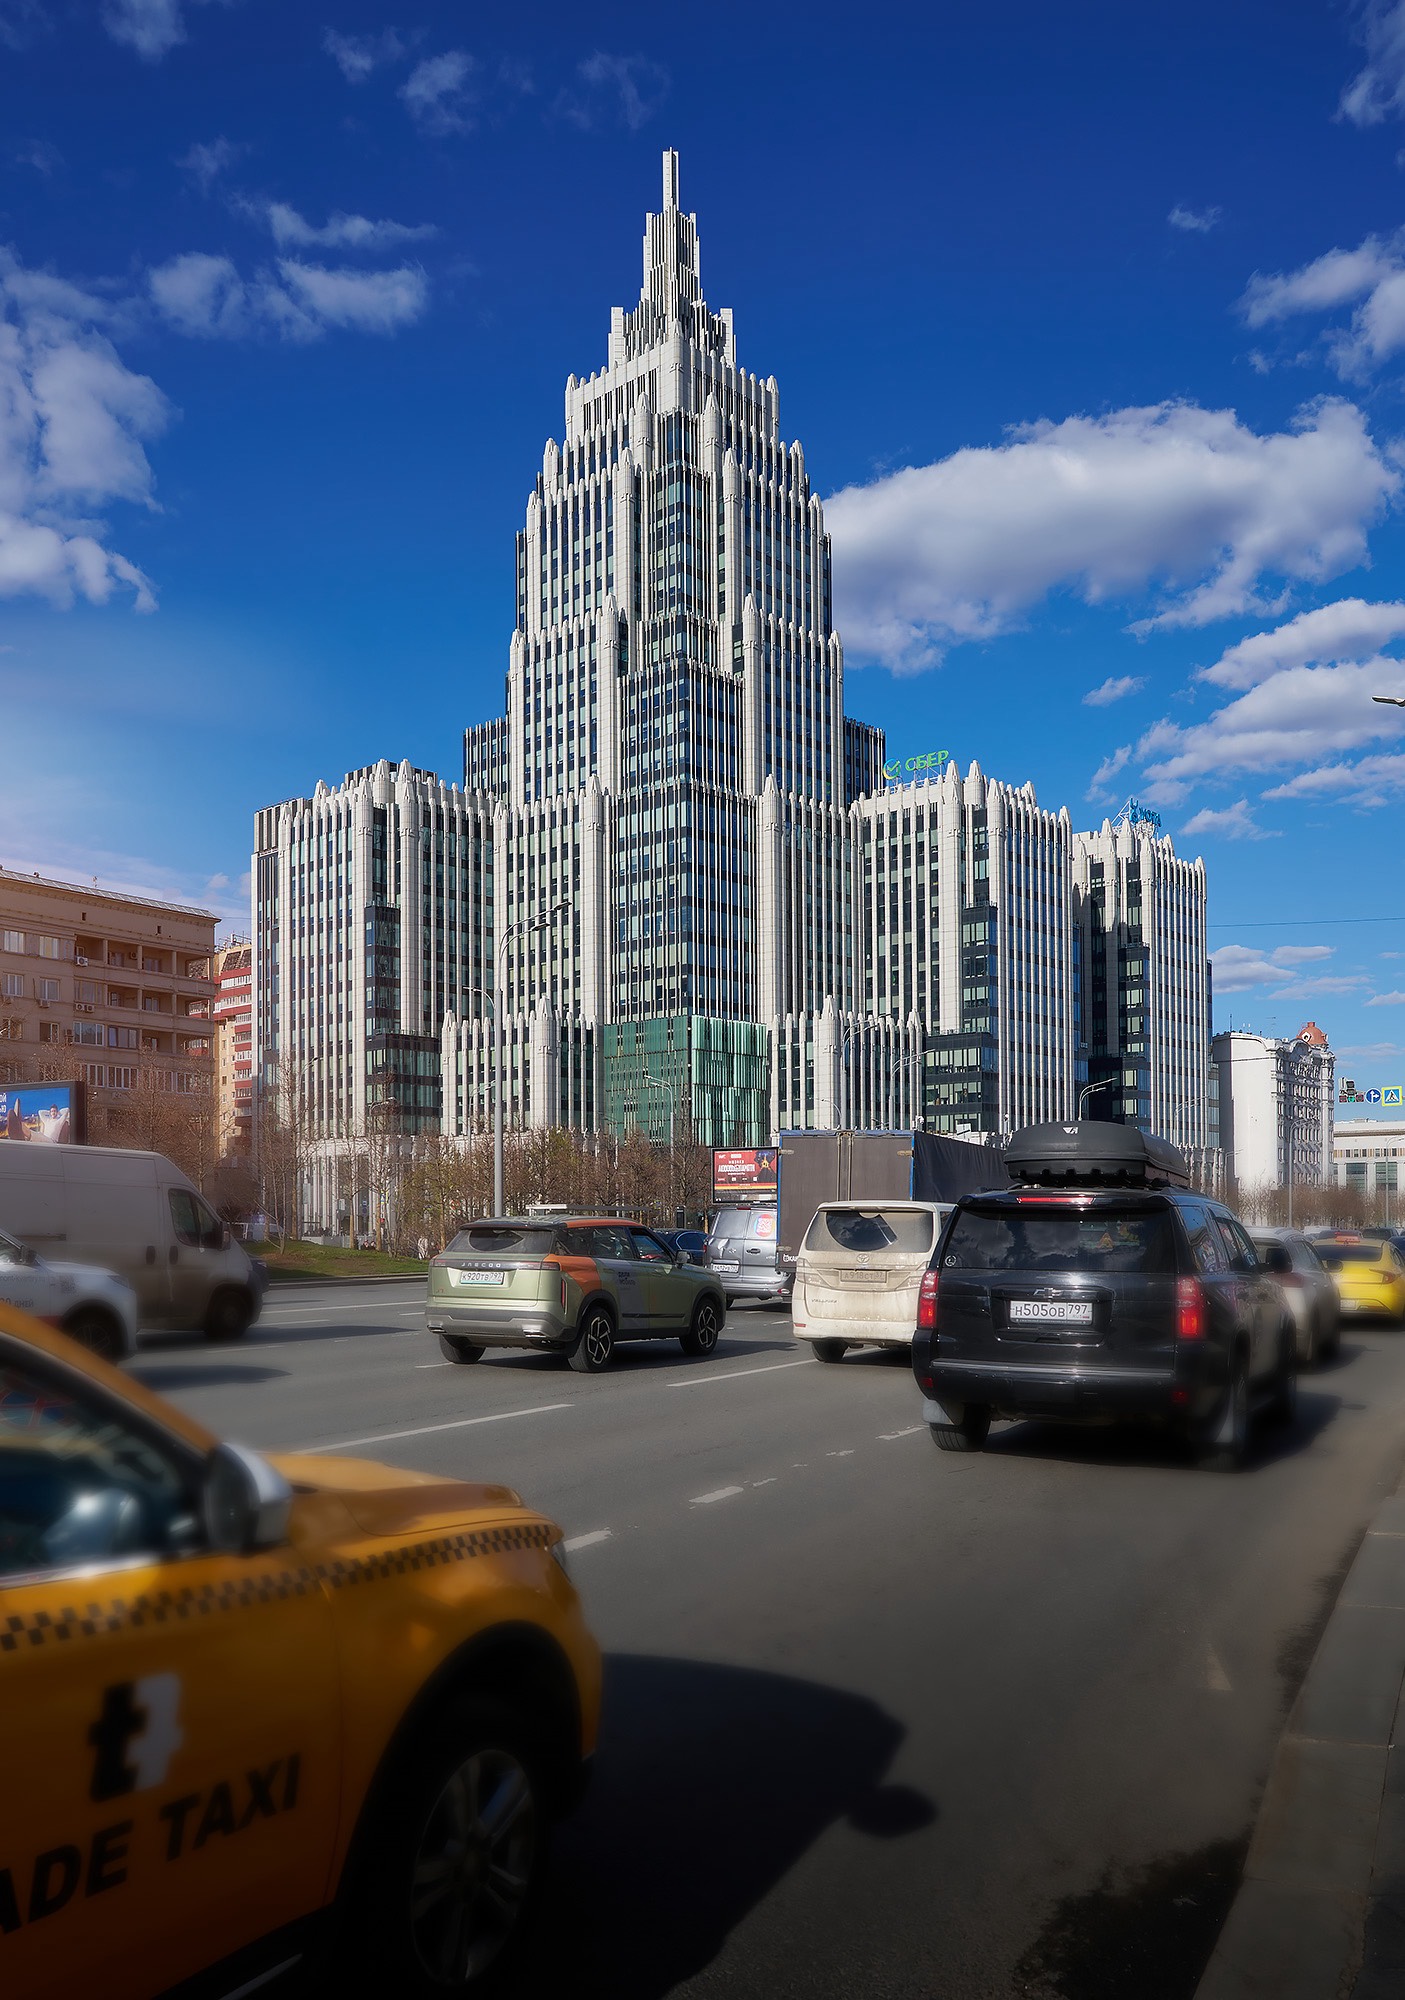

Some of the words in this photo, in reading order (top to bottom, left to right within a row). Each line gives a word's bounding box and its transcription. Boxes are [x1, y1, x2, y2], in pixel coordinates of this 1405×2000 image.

[905, 750, 949, 771] СБЕР
[1015, 1303, 1065, 1317] Н505ОВ
[1068, 1304, 1087, 1314] 797
[158, 1752, 303, 1862] TAXI
